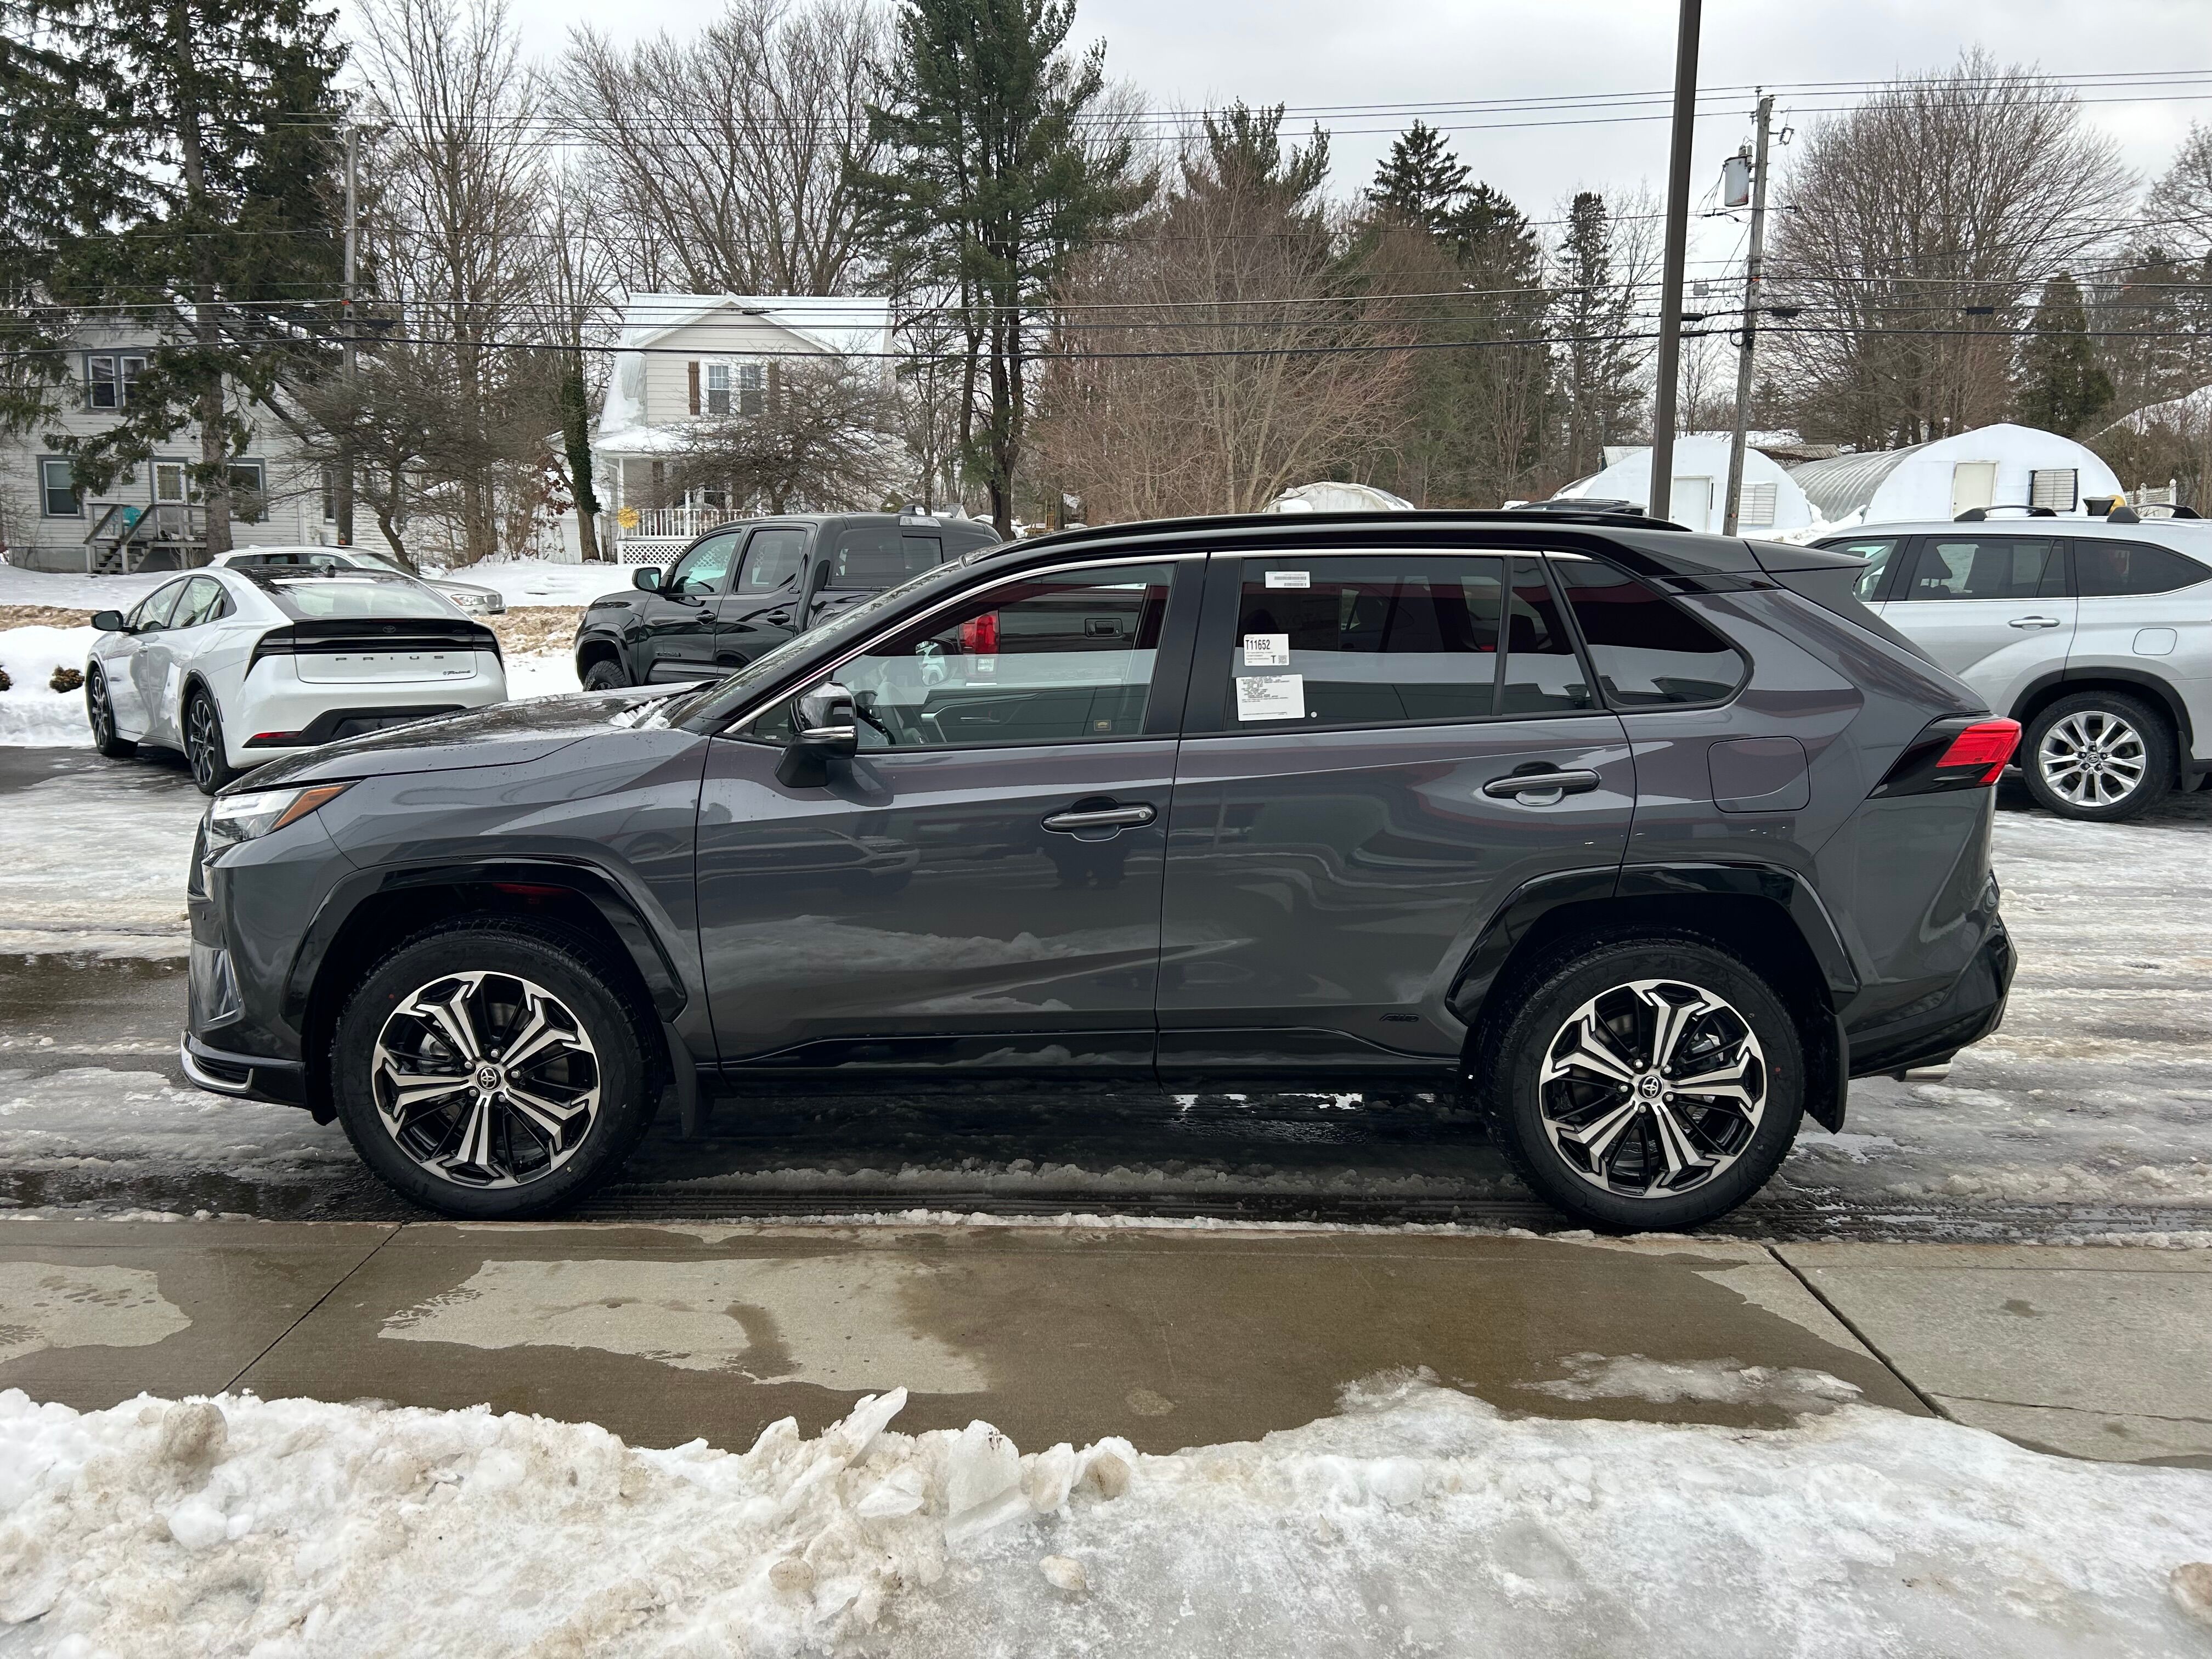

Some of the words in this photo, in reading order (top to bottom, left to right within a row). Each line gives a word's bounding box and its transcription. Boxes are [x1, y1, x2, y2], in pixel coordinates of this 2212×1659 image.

[1245, 639, 1271, 650] T11652
[1271, 655, 1276, 664] T
[1379, 1013, 1419, 1022] AWD
